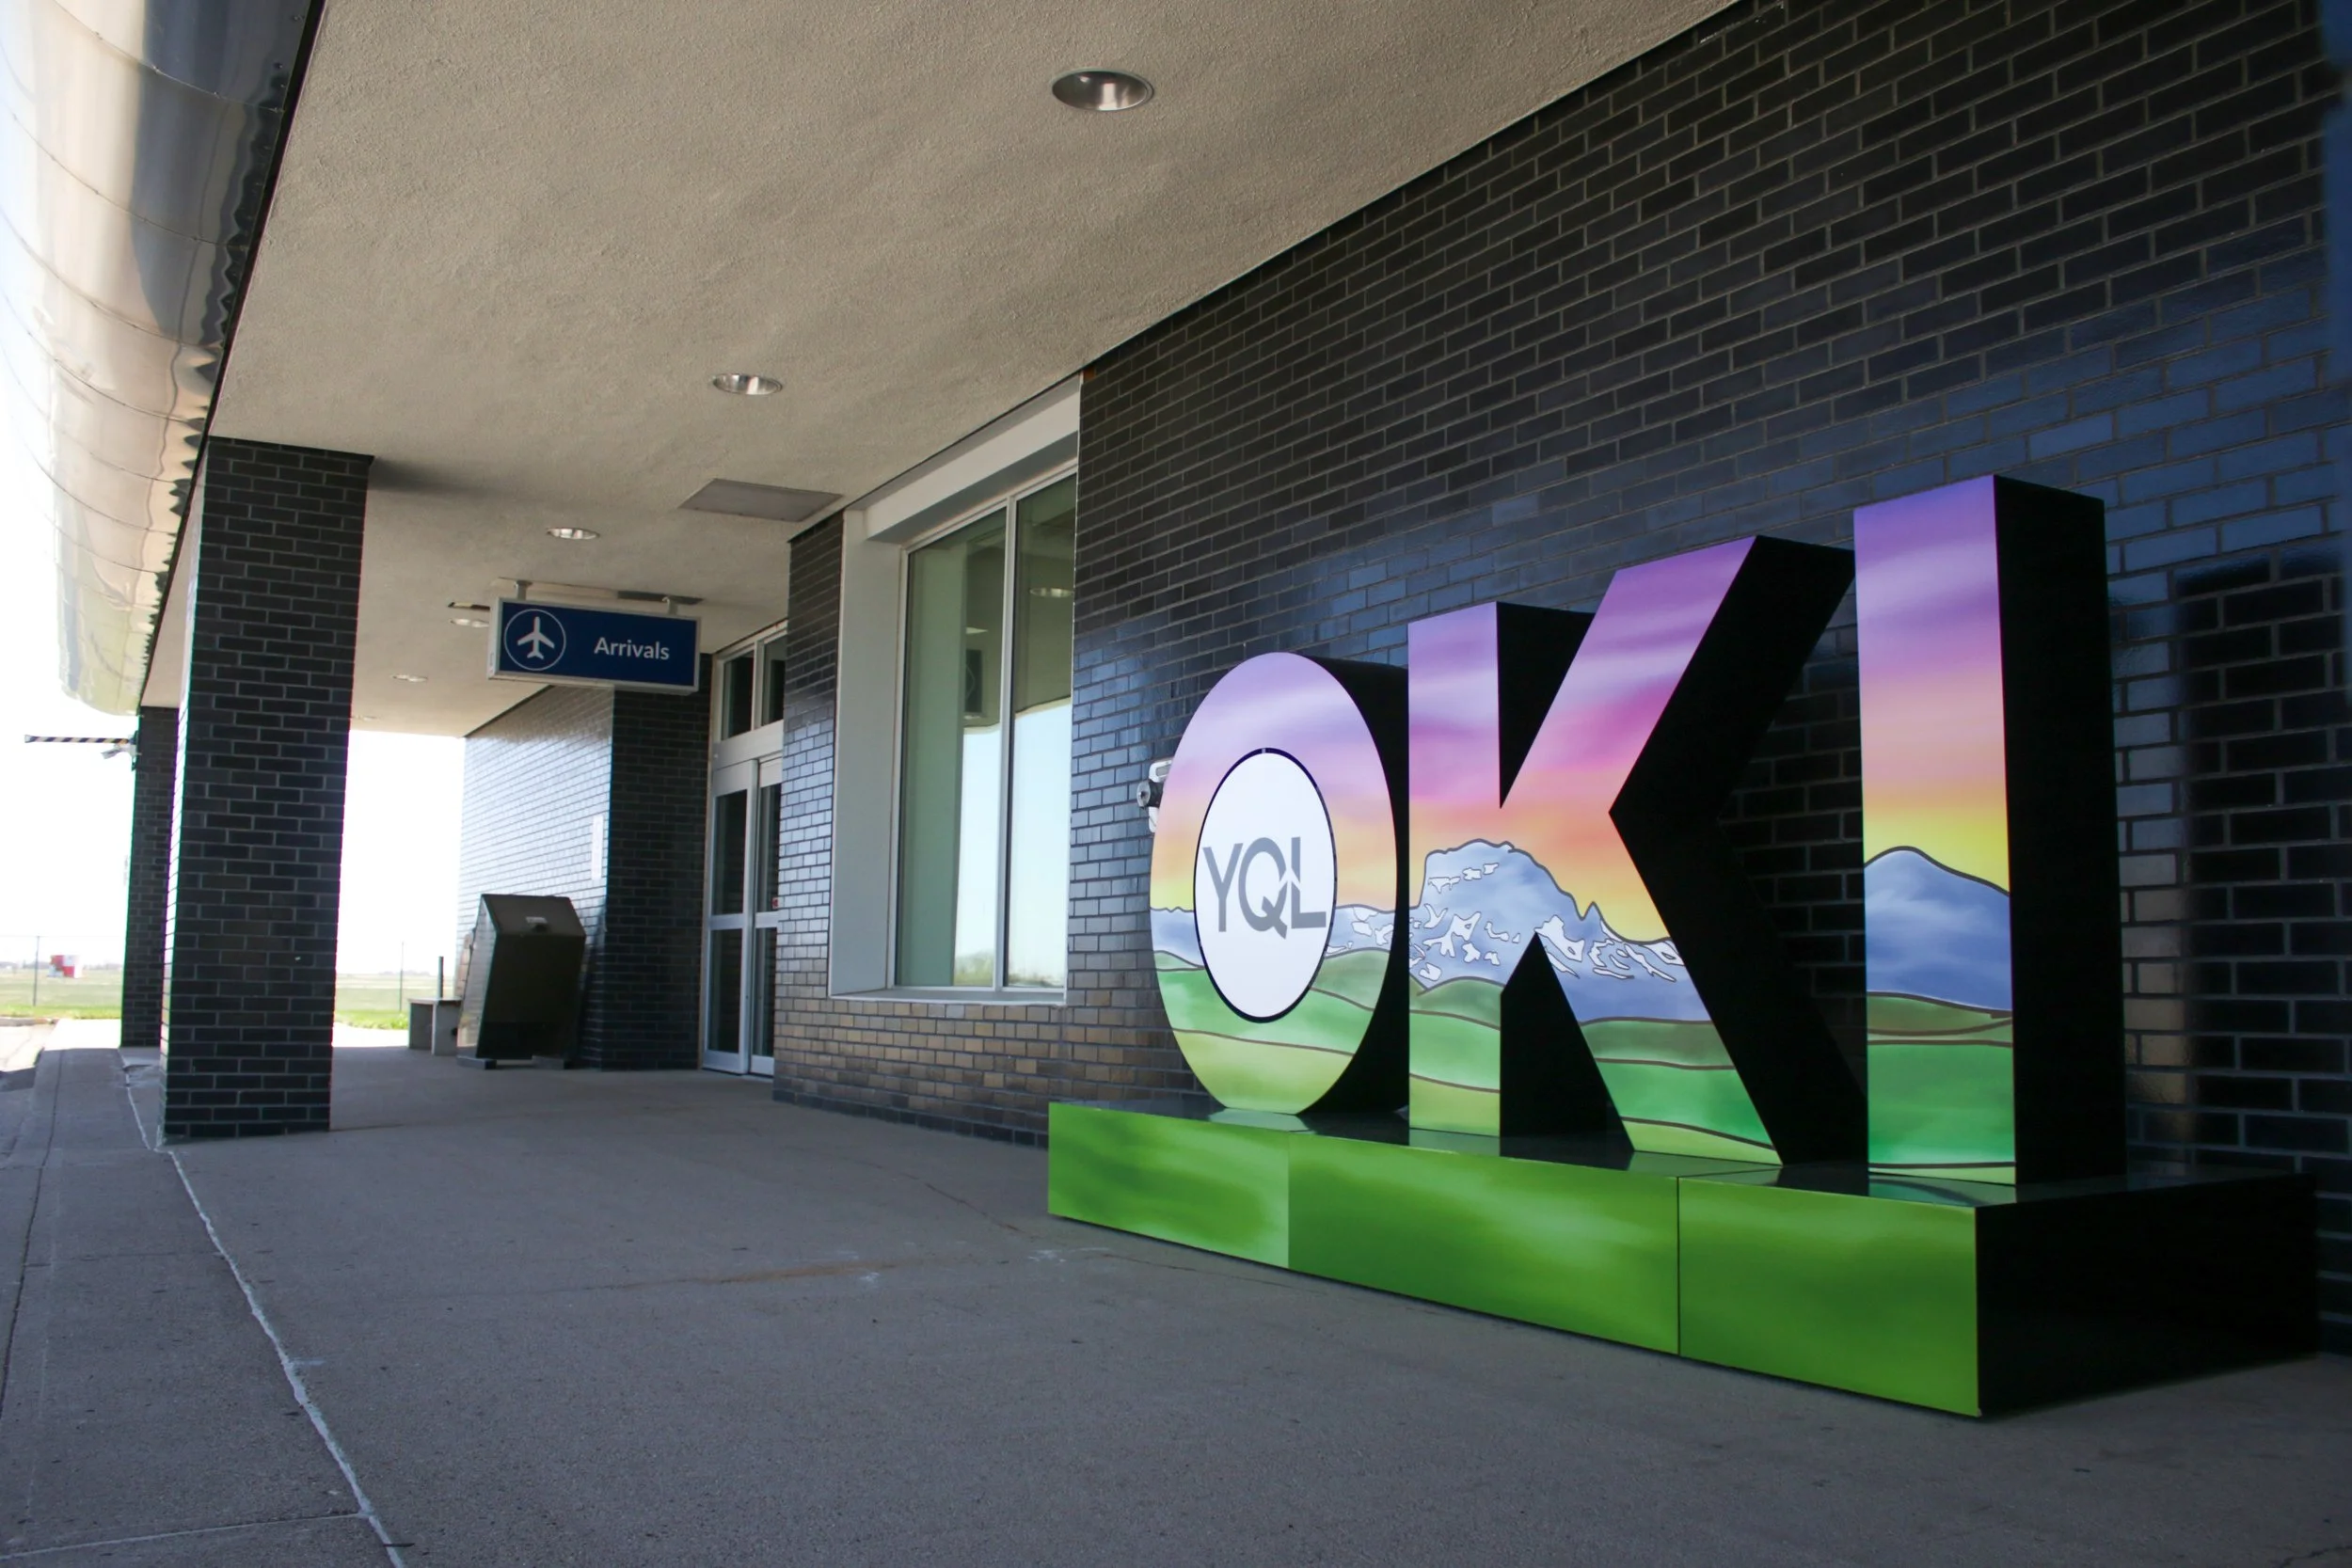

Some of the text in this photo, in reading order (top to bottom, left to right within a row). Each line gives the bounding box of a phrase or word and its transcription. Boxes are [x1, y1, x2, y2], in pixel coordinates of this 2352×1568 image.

[594, 637, 670, 660] Arrivals
[1150, 475, 2016, 1185] OKI
[1202, 836, 1327, 940] YQL
